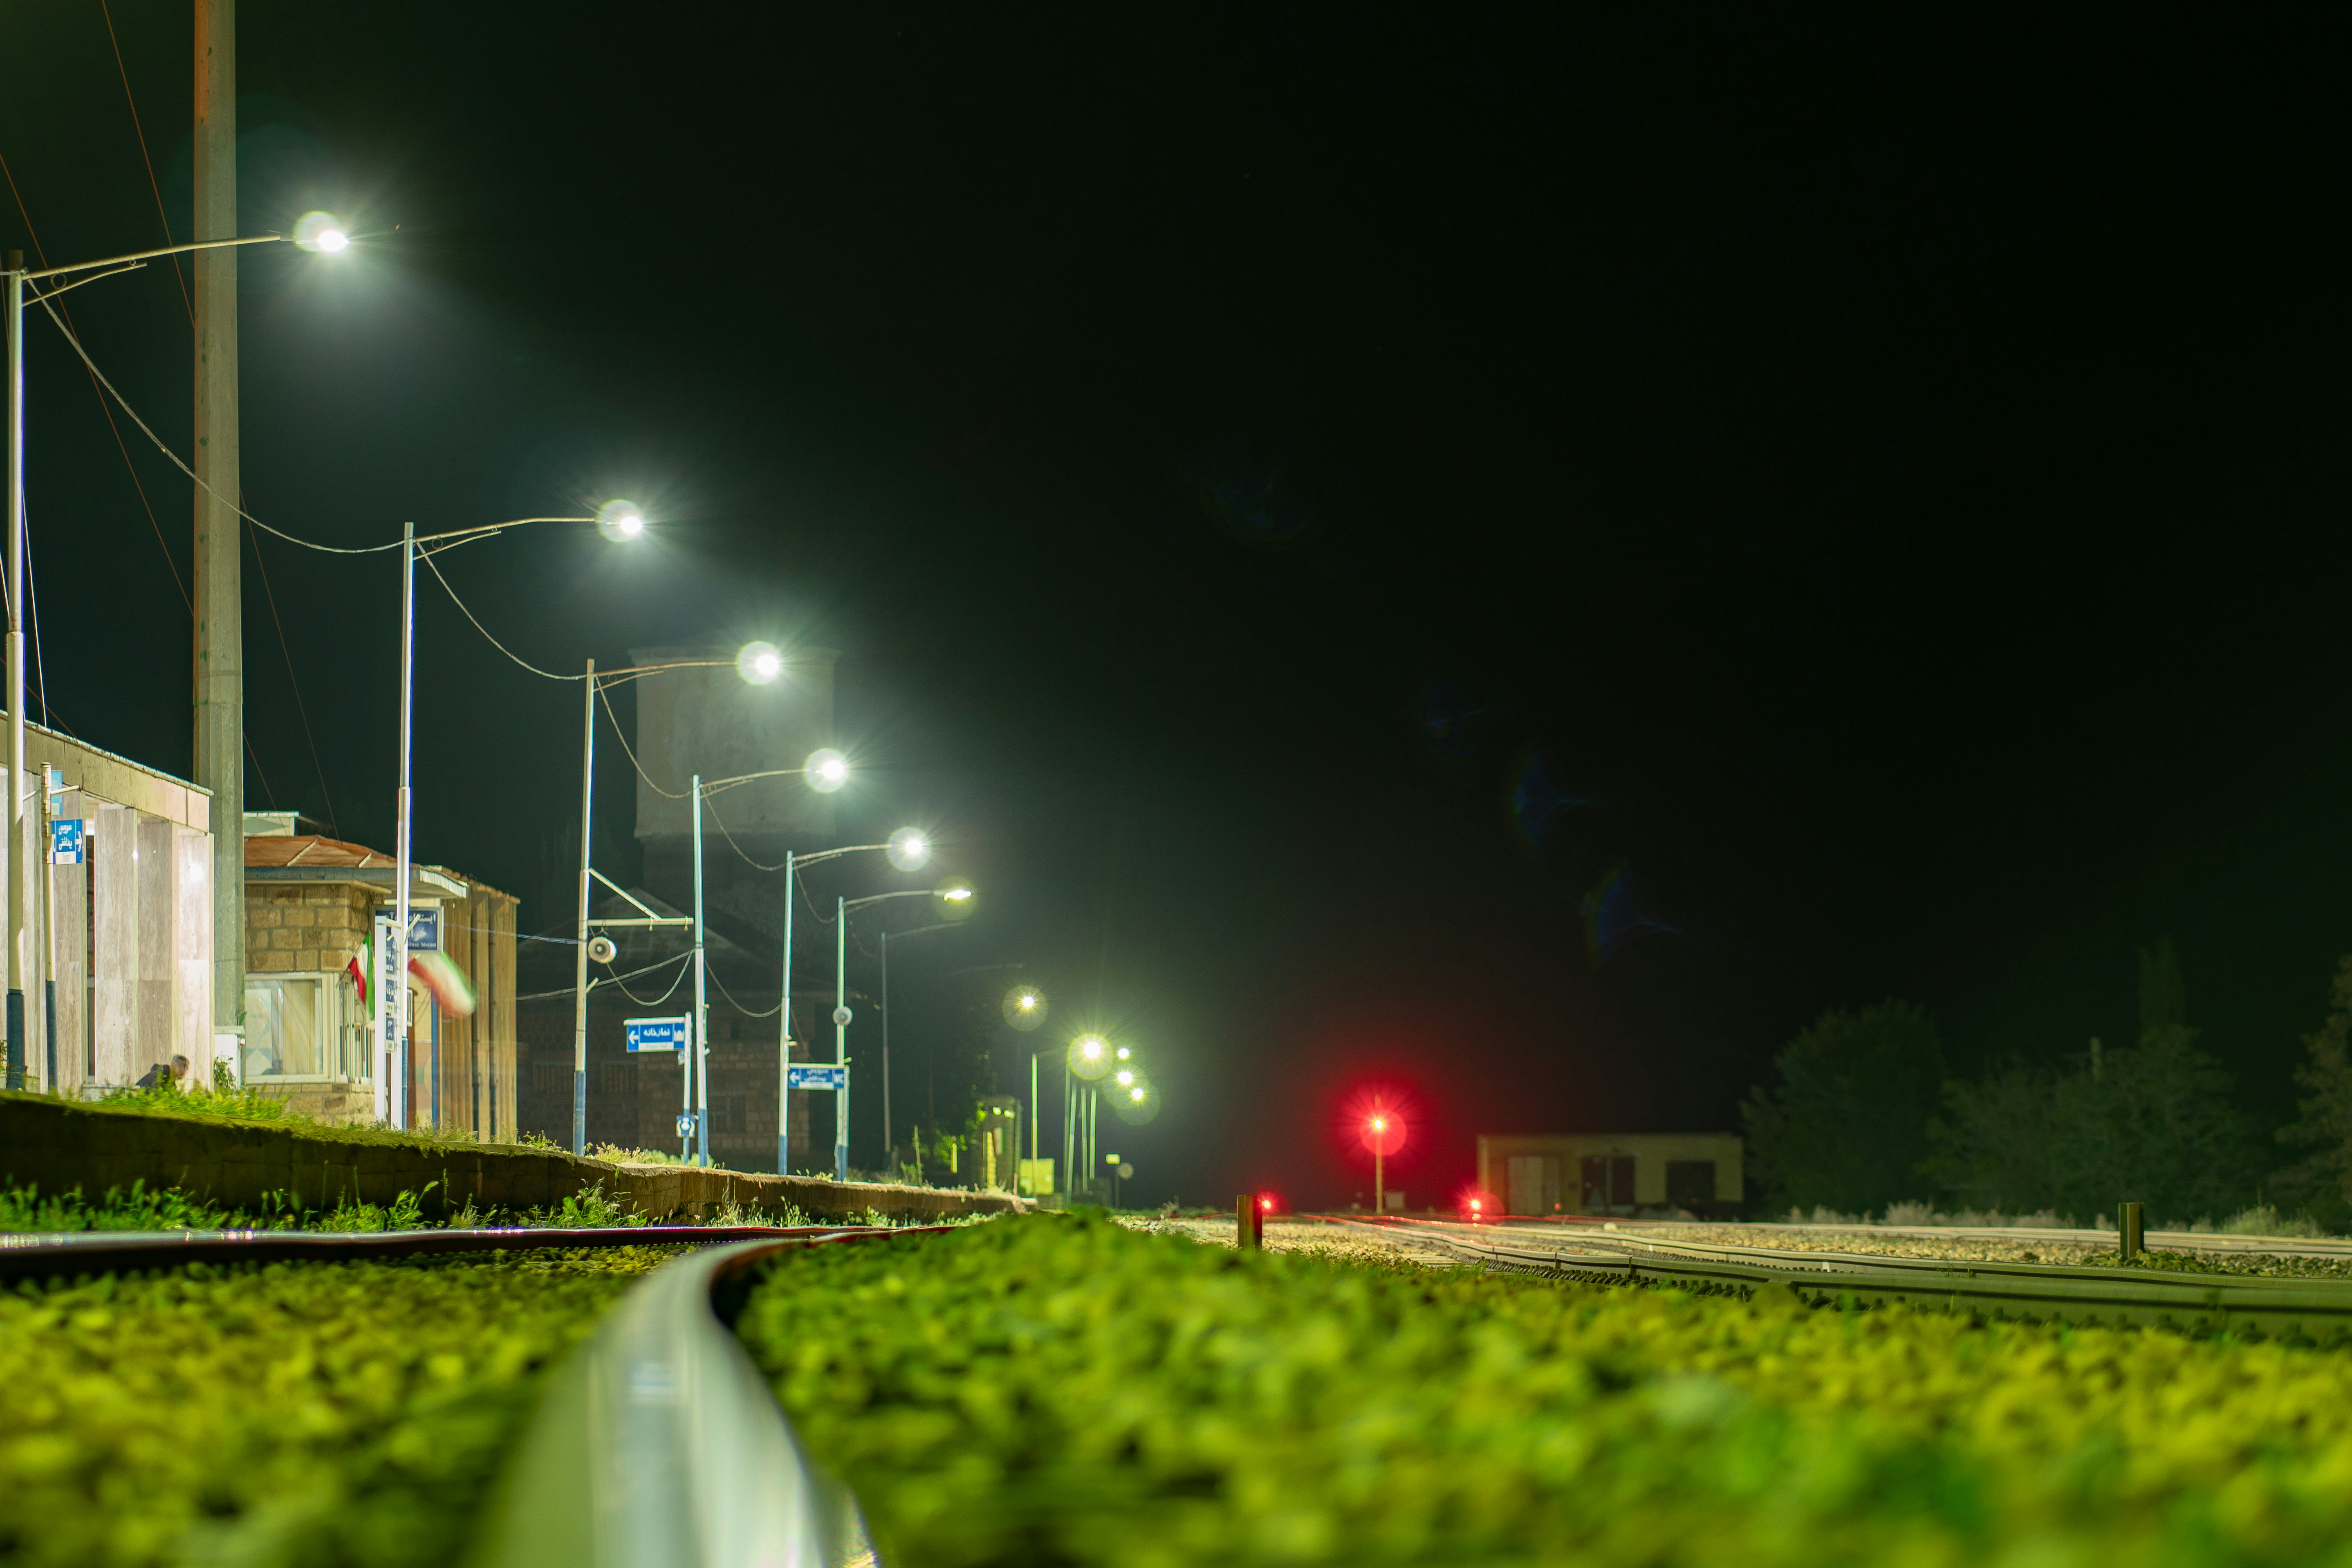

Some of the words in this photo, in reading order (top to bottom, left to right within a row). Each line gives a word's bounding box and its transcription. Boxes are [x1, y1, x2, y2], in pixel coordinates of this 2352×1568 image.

[58, 824, 72, 835] سرویس
[58, 837, 72, 850] بهداشتی
[409, 912, 436, 924] ایستاه
[643, 1027, 670, 1037] نمازخانه
[834, 1073, 844, 1084] WC
